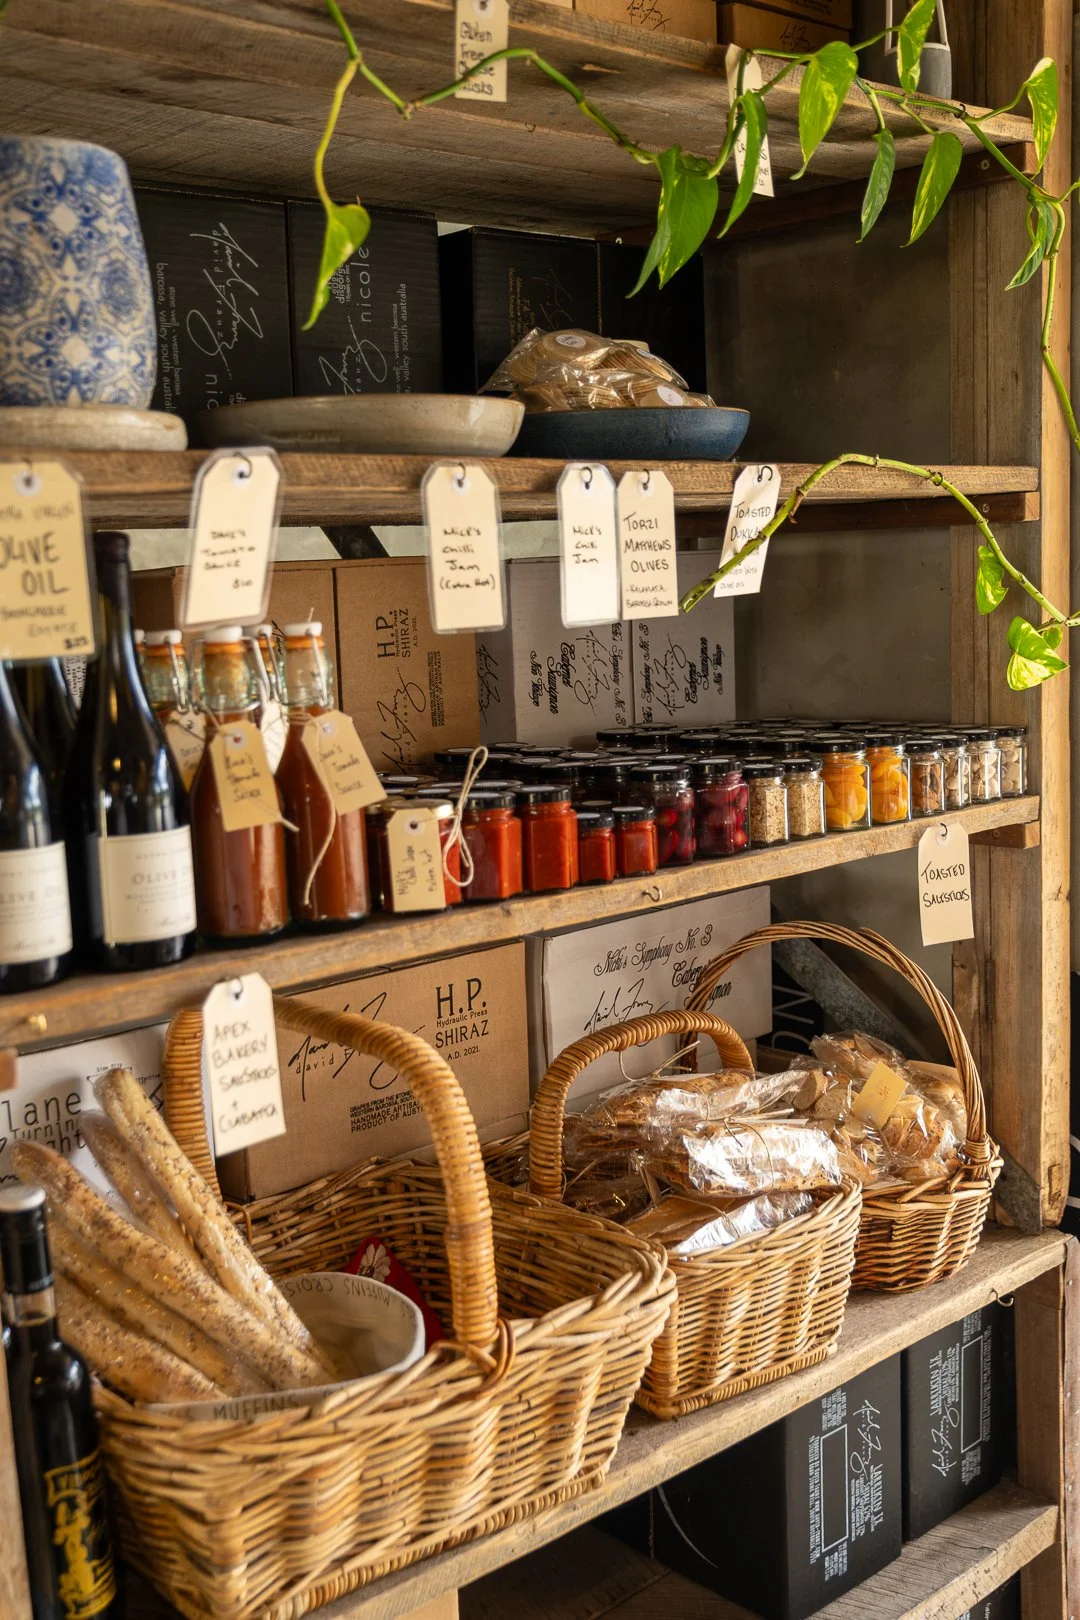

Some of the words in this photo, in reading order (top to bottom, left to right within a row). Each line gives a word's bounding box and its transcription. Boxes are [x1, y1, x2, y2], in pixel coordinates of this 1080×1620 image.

[460, 43, 486, 60] Free
[156, 263, 169, 305] barossa,
[351, 246, 372, 322] nicole
[398, 283, 407, 321] australia
[159, 311, 172, 339] valley
[170, 309, 179, 326] well
[171, 335, 179, 365] western
[399, 325, 409, 351] south
[161, 344, 173, 372] south
[400, 354, 410, 381] valley
[164, 377, 175, 412] australi
[733, 500, 772, 519] TOASTED
[624, 538, 672, 554] MATTHEWS
[630, 558, 669, 574] OLIVES
[22, 569, 69, 596] OIL
[375, 610, 396, 659] H.P.
[399, 608, 411, 658] SHIRAZ
[920, 861, 965, 884] TOASTED
[631, 936, 673, 972] Symphony
[676, 927, 700, 953] No.
[700, 924, 713, 946] 3
[436, 978, 487, 1019] H.P.
[436, 1014, 468, 1028] Hydraulic
[470, 1010, 488, 1020] Press
[435, 1020, 490, 1048] SHIRAZ
[212, 1033, 268, 1068] BAKERY
[447, 1052, 462, 1062] A.D.
[1, 1092, 82, 1132] lane
[351, 1108, 392, 1126] HANDMADE
[393, 1100, 418, 1114] ARTISA
[351, 1116, 388, 1134] PRODUCT
[390, 1112, 400, 1122] OF
[11, 1119, 80, 1140] Turnin
